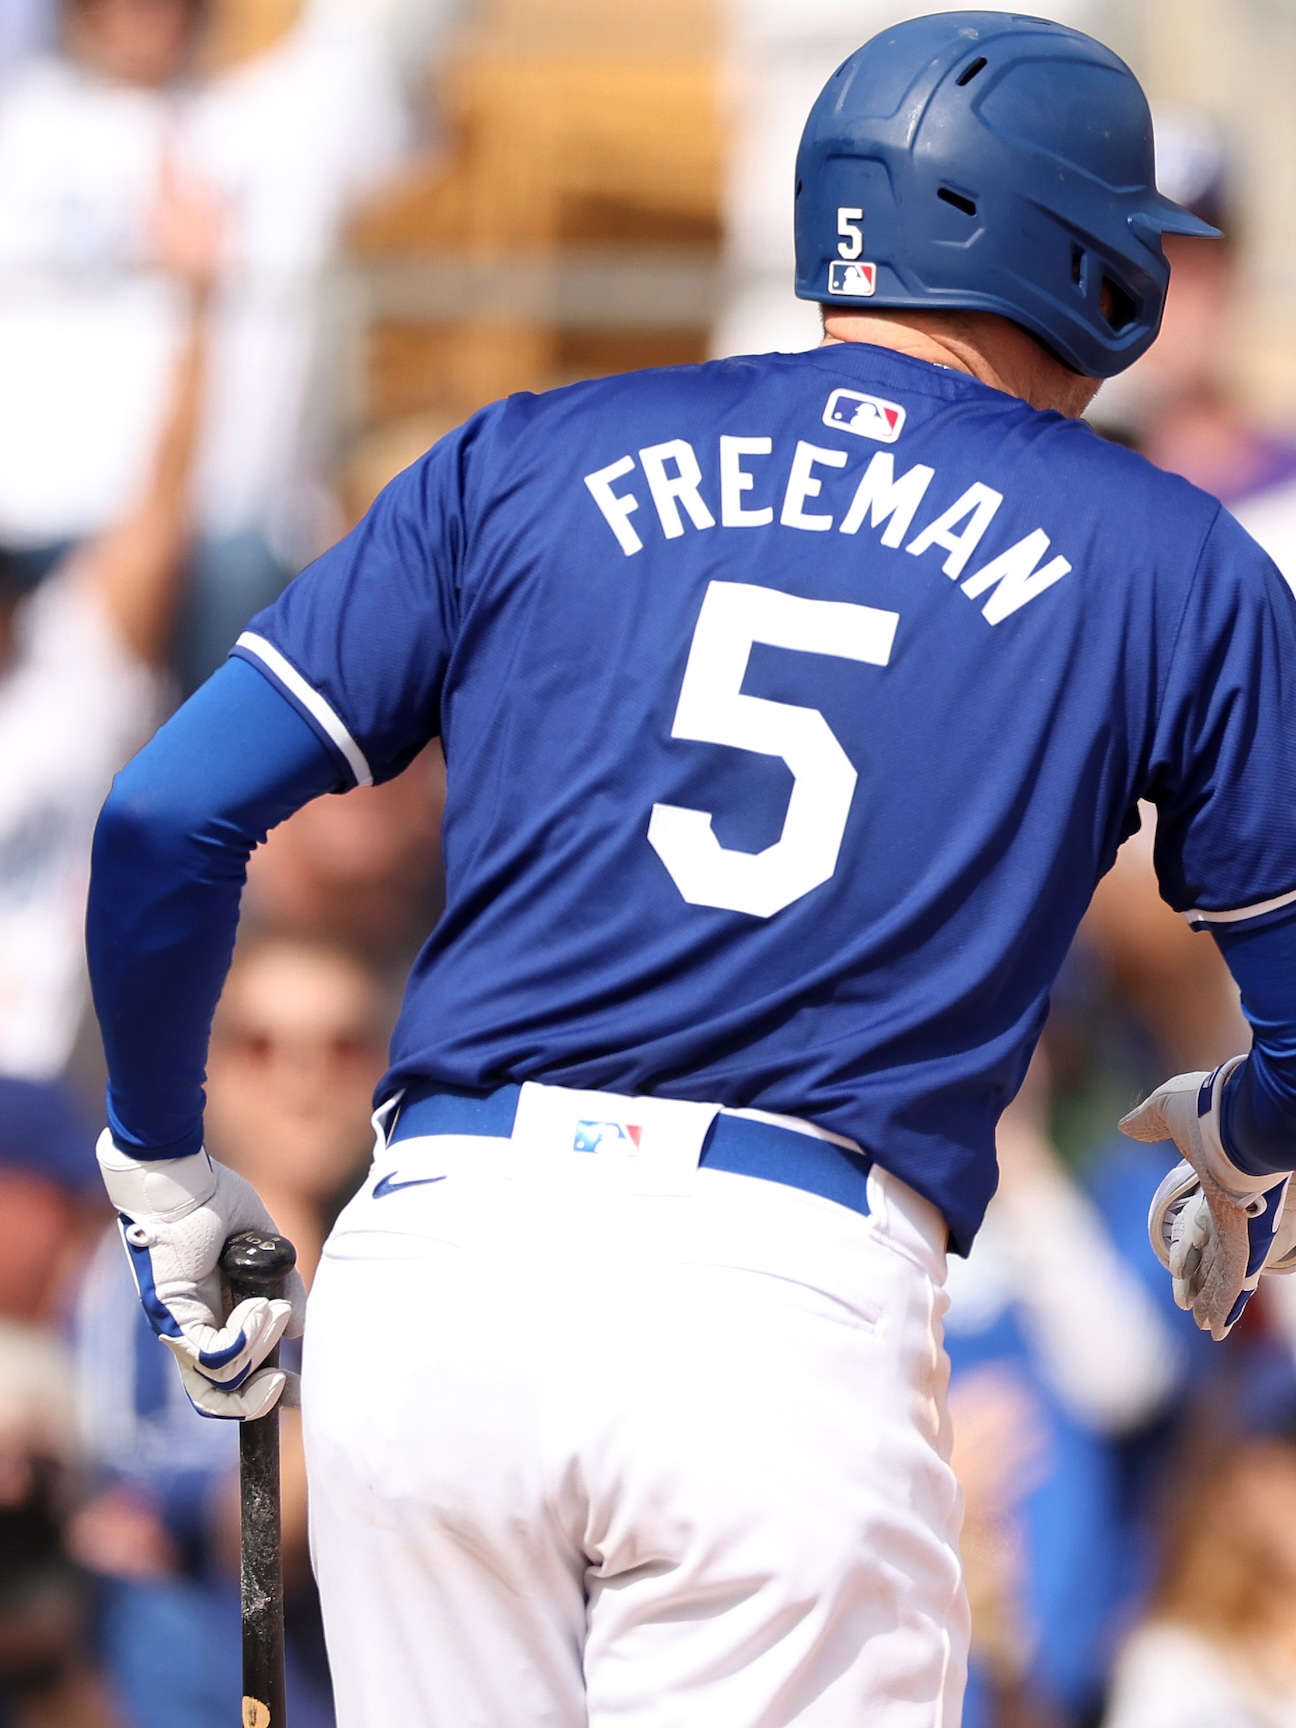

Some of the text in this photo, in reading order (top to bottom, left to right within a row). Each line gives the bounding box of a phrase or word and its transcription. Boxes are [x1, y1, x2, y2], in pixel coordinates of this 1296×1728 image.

[838, 207, 863, 260] 5
[584, 435, 1073, 626] FREEMAN
[647, 580, 900, 919] 5
